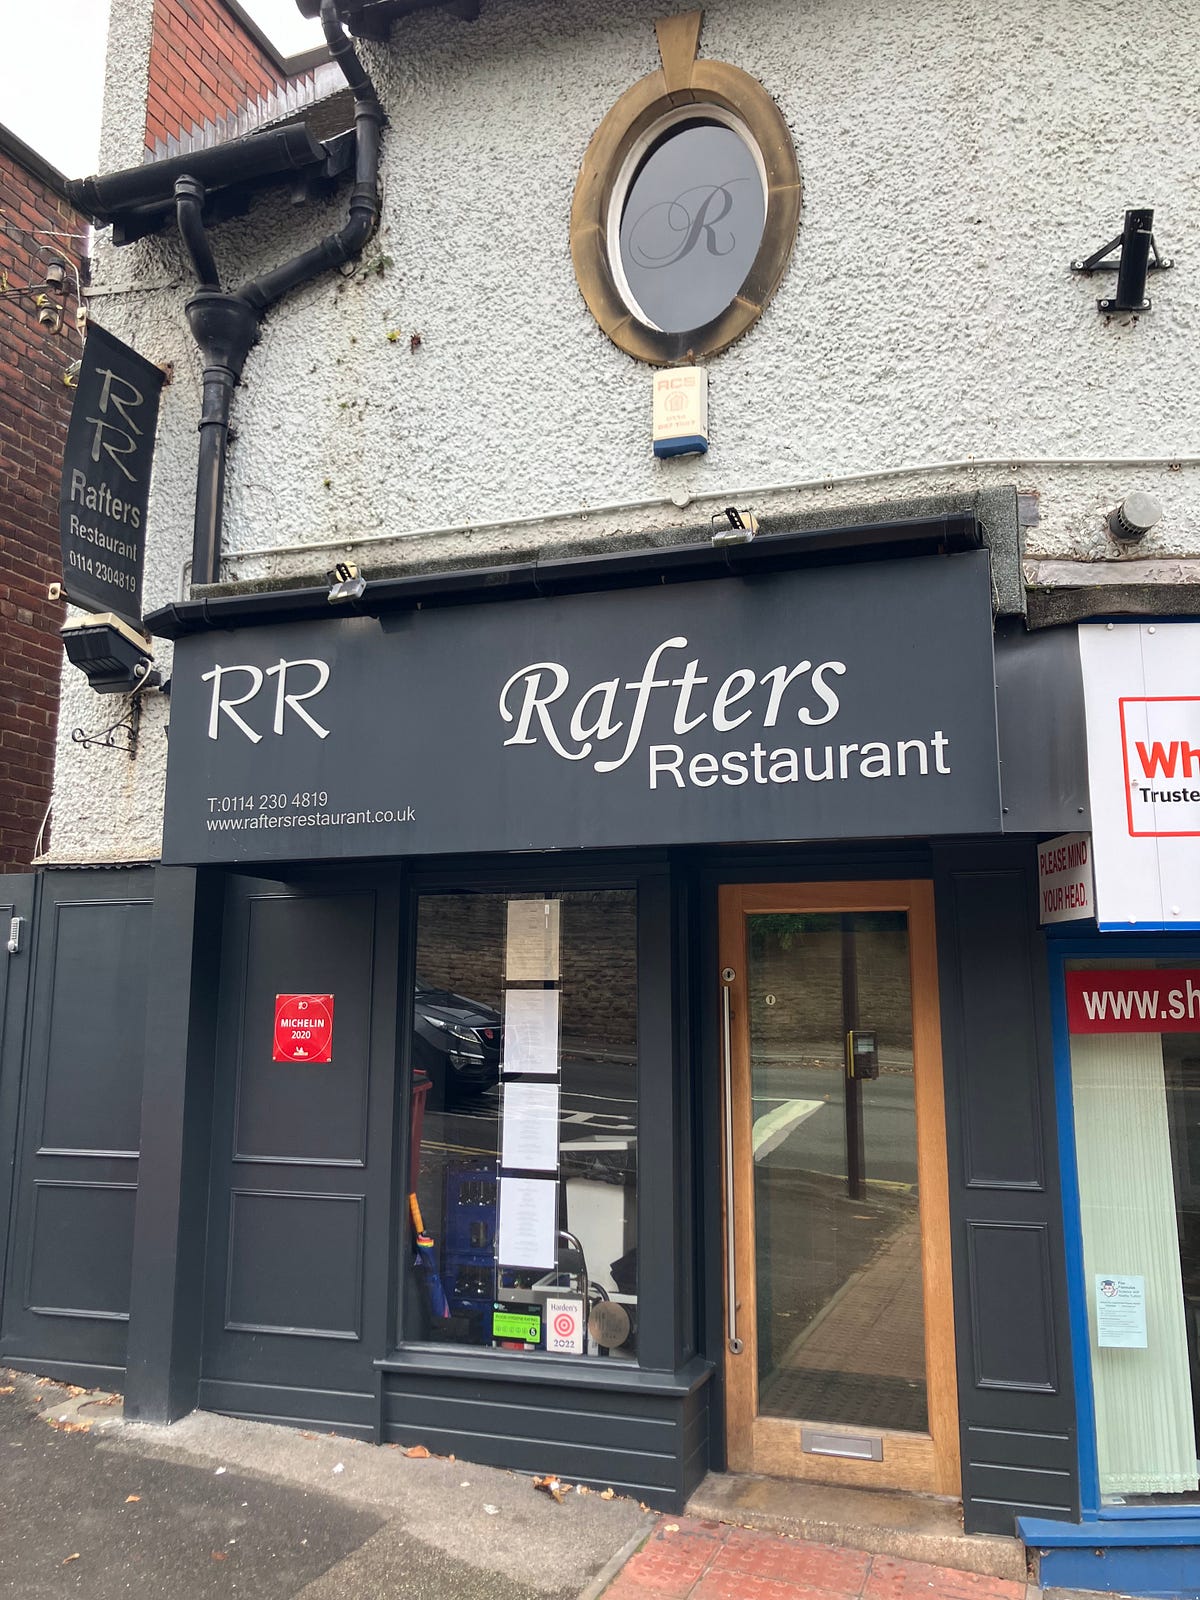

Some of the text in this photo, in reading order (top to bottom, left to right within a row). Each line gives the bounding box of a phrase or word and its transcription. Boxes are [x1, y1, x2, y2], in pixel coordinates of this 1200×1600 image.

[628, 177, 750, 269] R
[95, 367, 145, 436] R
[85, 416, 138, 482] R
[70, 467, 141, 529] Rafters
[69, 514, 138, 562] Restaurant
[69, 550, 137, 593] 0114 2304819
[201, 657, 331, 744] RR
[498, 635, 847, 773] Rafters
[648, 730, 952, 790] Restaurant
[206, 806, 417, 831] www.raftersrestaurant.co.uk
[207, 791, 329, 813] T:0114 230 4819
[1040, 840, 1088, 877] PLEASE MIND
[1043, 882, 1088, 913] YOUR HEAD.
[1082, 979, 1200, 1020] www.sh
[280, 1018, 325, 1028] MICHELIN
[291, 1030, 311, 1040] 2020
[550, 1303, 578, 1313] Harden's
[553, 1338, 575, 1349] 2022
